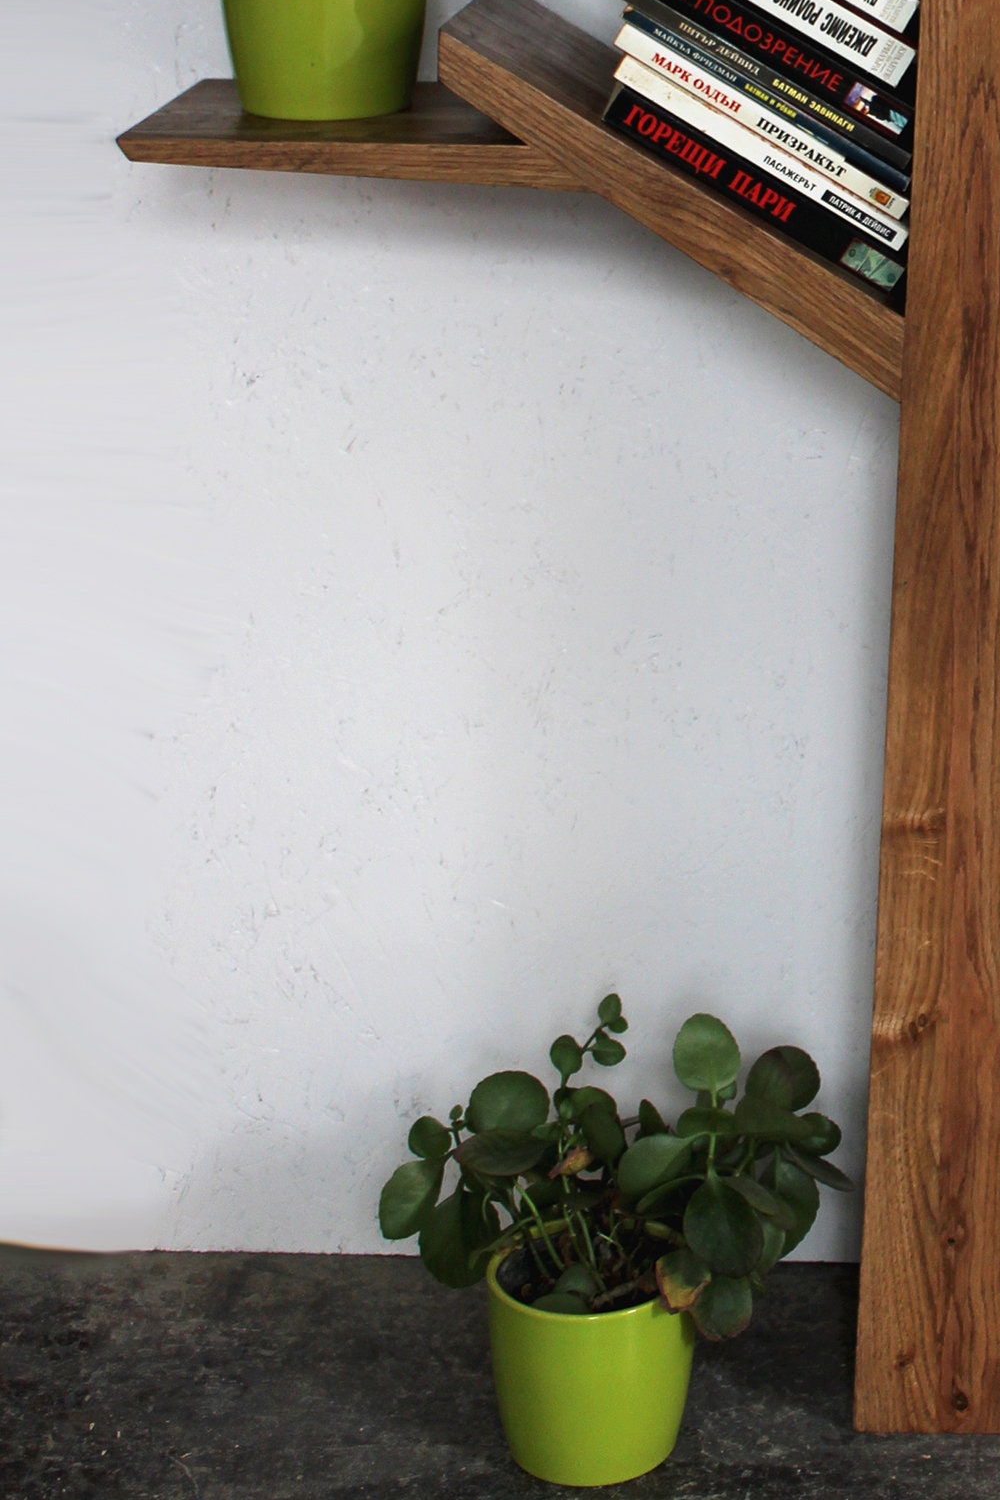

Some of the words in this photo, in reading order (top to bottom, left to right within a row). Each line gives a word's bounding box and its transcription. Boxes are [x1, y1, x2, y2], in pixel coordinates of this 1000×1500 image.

[654, 29, 690, 54] МАЙКЪЛ
[680, 23, 716, 46] ПИТЪР
[716, 46, 760, 75] ДЕЙВИД
[773, 79, 808, 103] БАТМАН
[810, 101, 854, 131] ЗАВИНАГИ
[820, 13, 878, 56] ДЖЕЙМС
[652, 53, 691, 82] МАРК
[694, 79, 741, 112] ОЛДЪН
[756, 118, 846, 176] ПРИЗРАКЪТ
[624, 106, 726, 178] ГОРЕЩИ
[729, 171, 795, 222] ПАРИ
[764, 156, 816, 190] ПАСАЖЕРЪТ
[829, 196, 856, 216] ПАТРИК
[862, 217, 890, 236] ДЕЙВИС
